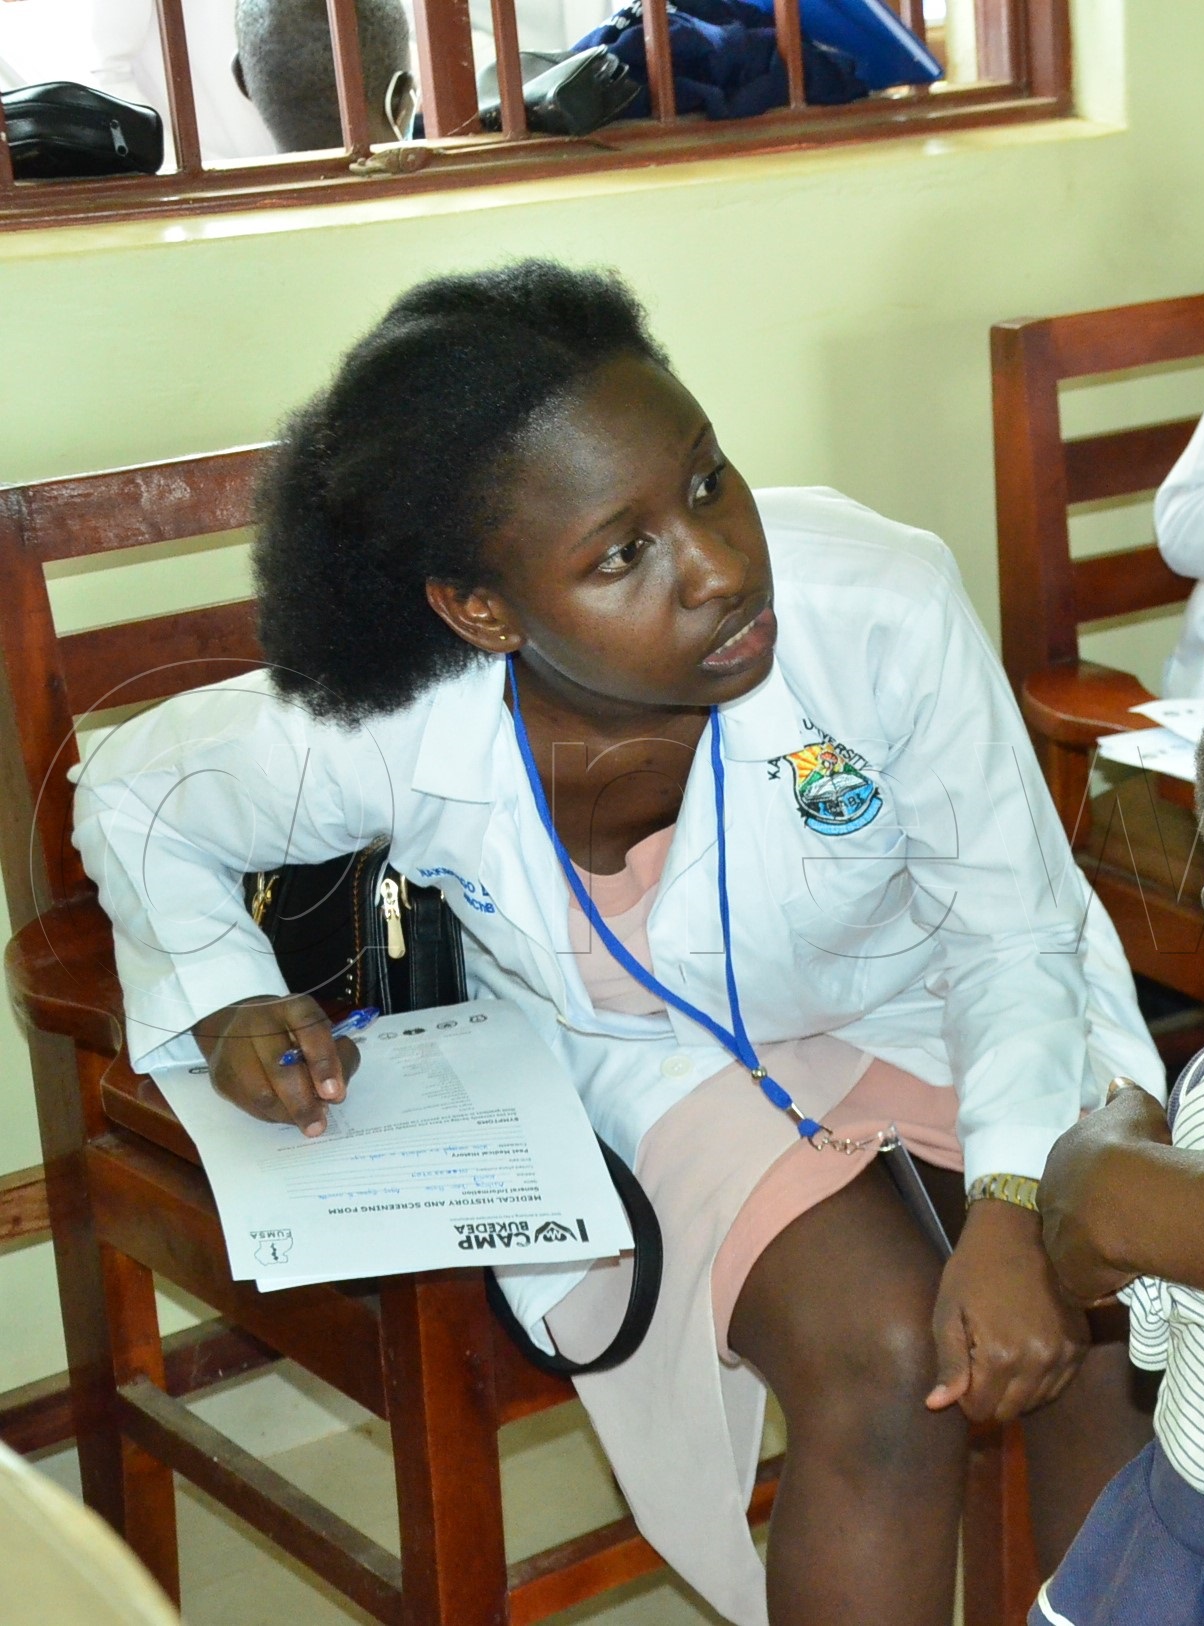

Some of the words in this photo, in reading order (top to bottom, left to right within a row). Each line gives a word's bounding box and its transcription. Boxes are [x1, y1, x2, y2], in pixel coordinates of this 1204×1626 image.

[802, 718, 873, 772] UIVERSITY
[461, 1188, 509, 1196] Information
[510, 1186, 540, 1194] General
[423, 1200, 446, 1208] AND
[448, 1197, 495, 1206] HISTORY
[328, 1206, 359, 1215] FORM
[360, 1202, 422, 1212] SCREENING
[453, 1220, 530, 1234] BUKEDEA
[576, 1218, 590, 1242] I
[249, 1230, 292, 1240] FUMSA
[457, 1231, 531, 1250] CAMP
